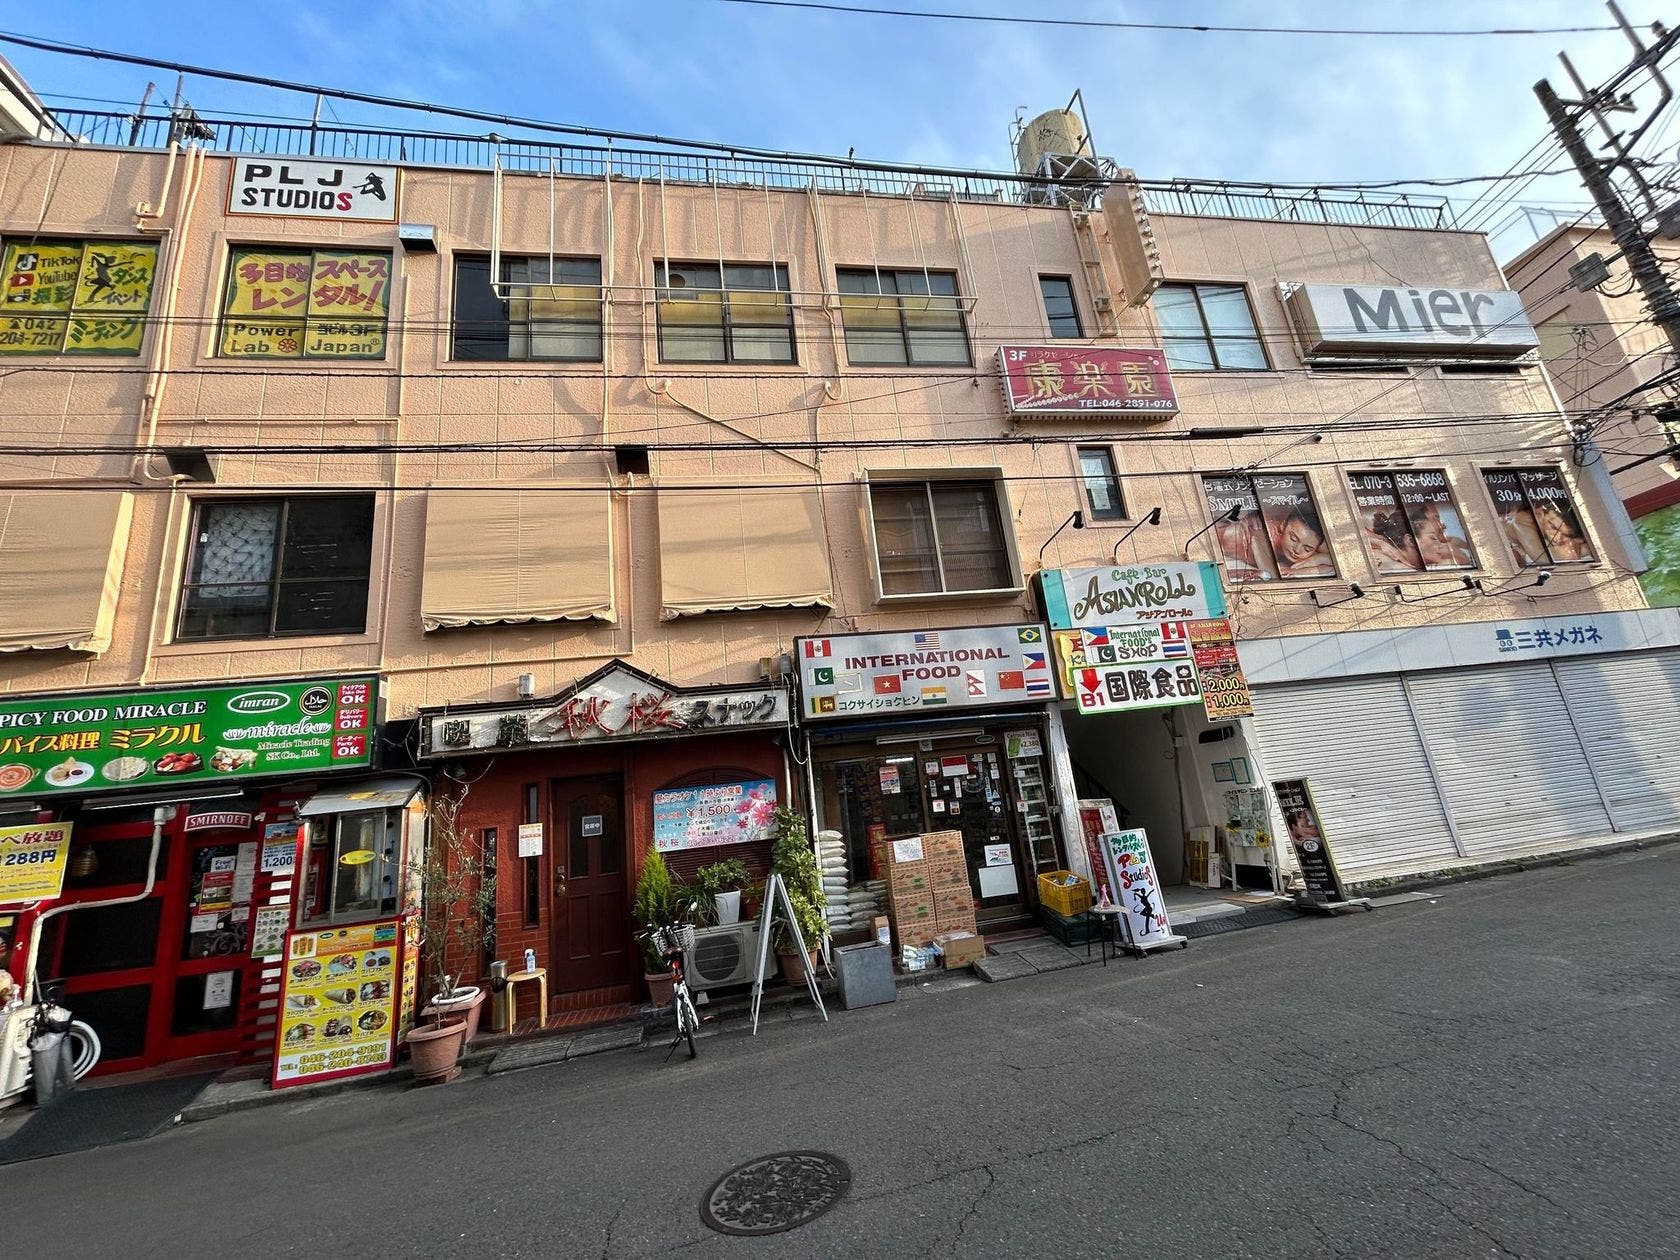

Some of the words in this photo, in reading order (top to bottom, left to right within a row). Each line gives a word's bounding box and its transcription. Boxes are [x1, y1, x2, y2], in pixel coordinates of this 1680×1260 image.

[241, 188, 353, 212] STUDIOS
[37, 270, 78, 285] YouTube
[239, 261, 310, 284] 多目的
[315, 259, 388, 280] スペース
[1342, 287, 1495, 338] Mier
[233, 322, 300, 338] Power
[231, 340, 270, 353] Lab
[1009, 350, 1027, 361] 3F
[1144, 567, 1167, 580] Bar
[844, 647, 1011, 670] INTERNATIONAL
[1117, 643, 1158, 660] SHOP
[902, 665, 962, 681] FOOD
[1105, 664, 1200, 703] 国際食品
[239, 697, 280, 709] imran
[340, 694, 365, 705] OK
[838, 696, 921, 712] コクサイショクヒン
[1080, 692, 1105, 708] B1
[51, 706, 108, 725] FOOD
[114, 700, 207, 720] MIRACLE
[247, 715, 313, 739] miracle
[340, 718, 362, 729] OK
[109, 723, 206, 749] ミラクル
[337, 745, 360, 757] OK
[190, 814, 247, 827] SMIRNOFF
